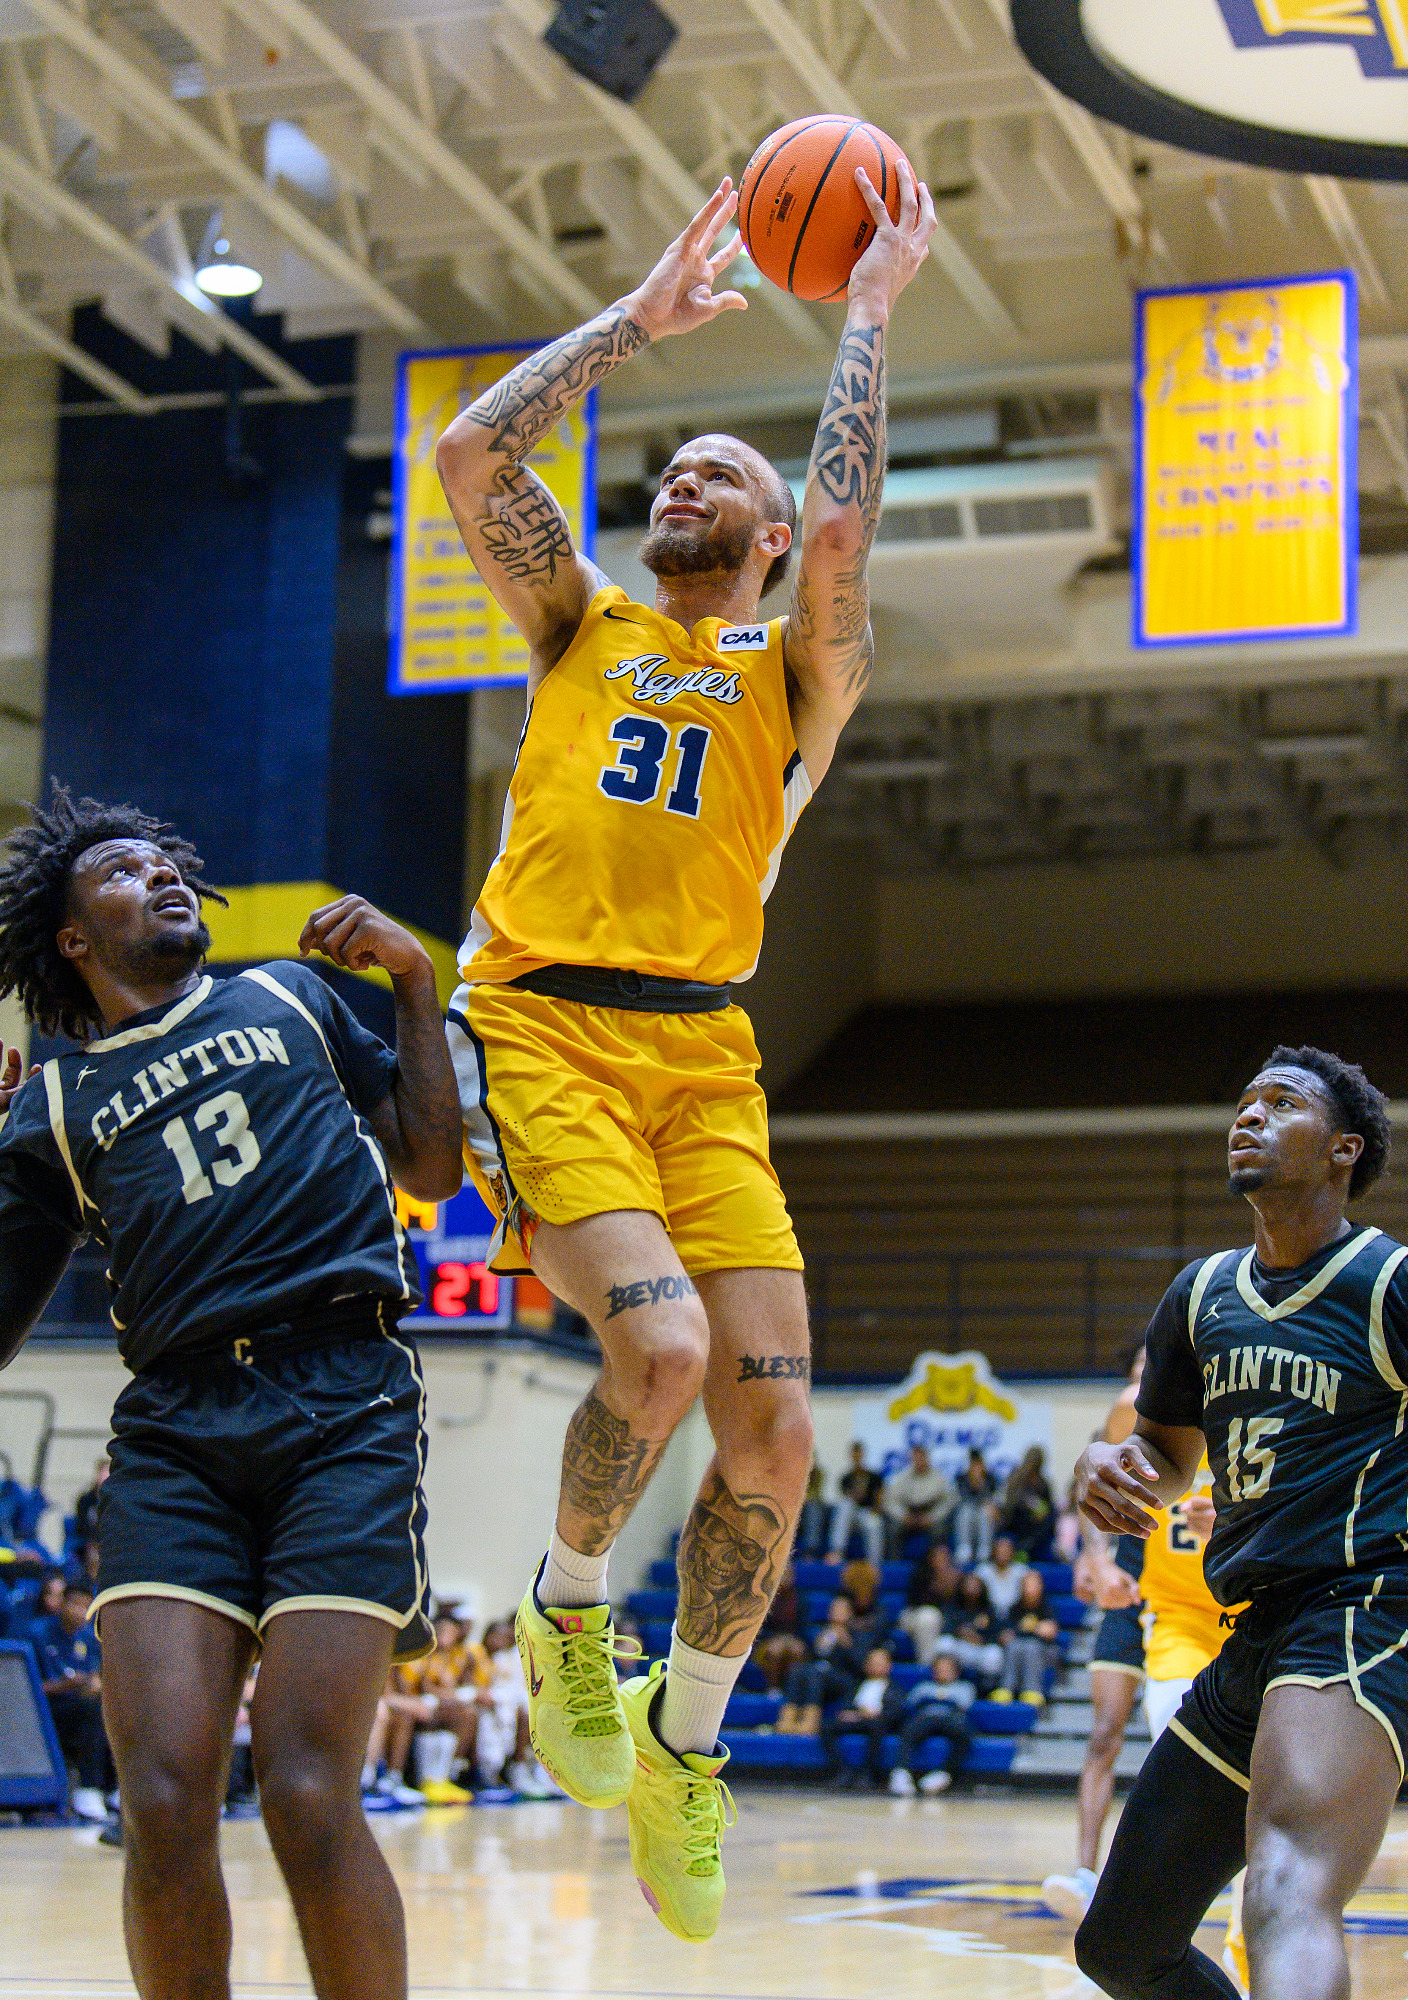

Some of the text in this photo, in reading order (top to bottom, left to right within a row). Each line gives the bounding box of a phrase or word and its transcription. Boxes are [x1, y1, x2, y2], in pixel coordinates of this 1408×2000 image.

[479, 511, 549, 581] God
[506, 485, 573, 584] FEAR
[721, 630, 765, 645] CAA
[604, 653, 744, 705] Aggies
[597, 713, 713, 820] 31
[91, 1027, 291, 1152] CLINTON
[161, 1090, 262, 1205] 13
[433, 1262, 499, 1317] 27
[1203, 1345, 1342, 1416] CLINTON
[1226, 1417, 1285, 1502] 15
